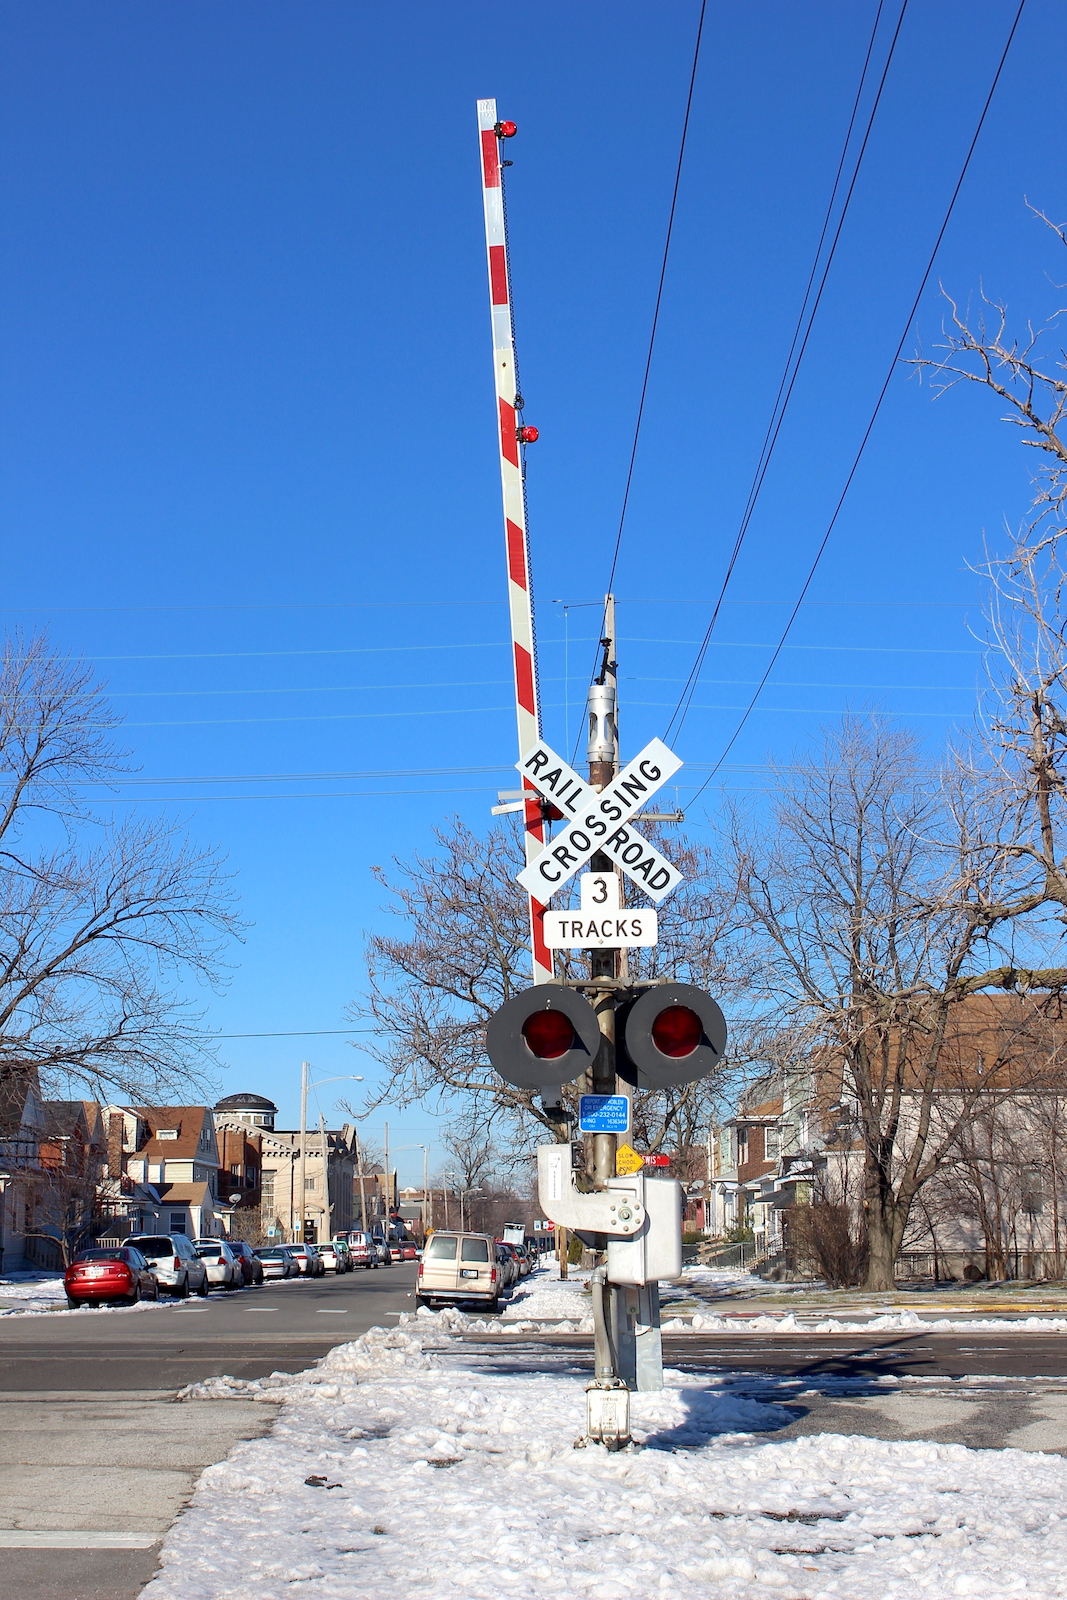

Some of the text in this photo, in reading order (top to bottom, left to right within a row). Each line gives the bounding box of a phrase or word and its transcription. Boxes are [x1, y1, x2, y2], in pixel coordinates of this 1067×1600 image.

[525, 749, 583, 813] RAIL
[539, 760, 662, 882] CROSSING
[606, 827, 671, 890] ROAD
[592, 879, 608, 904] 3
[558, 919, 643, 938] TRACKS
